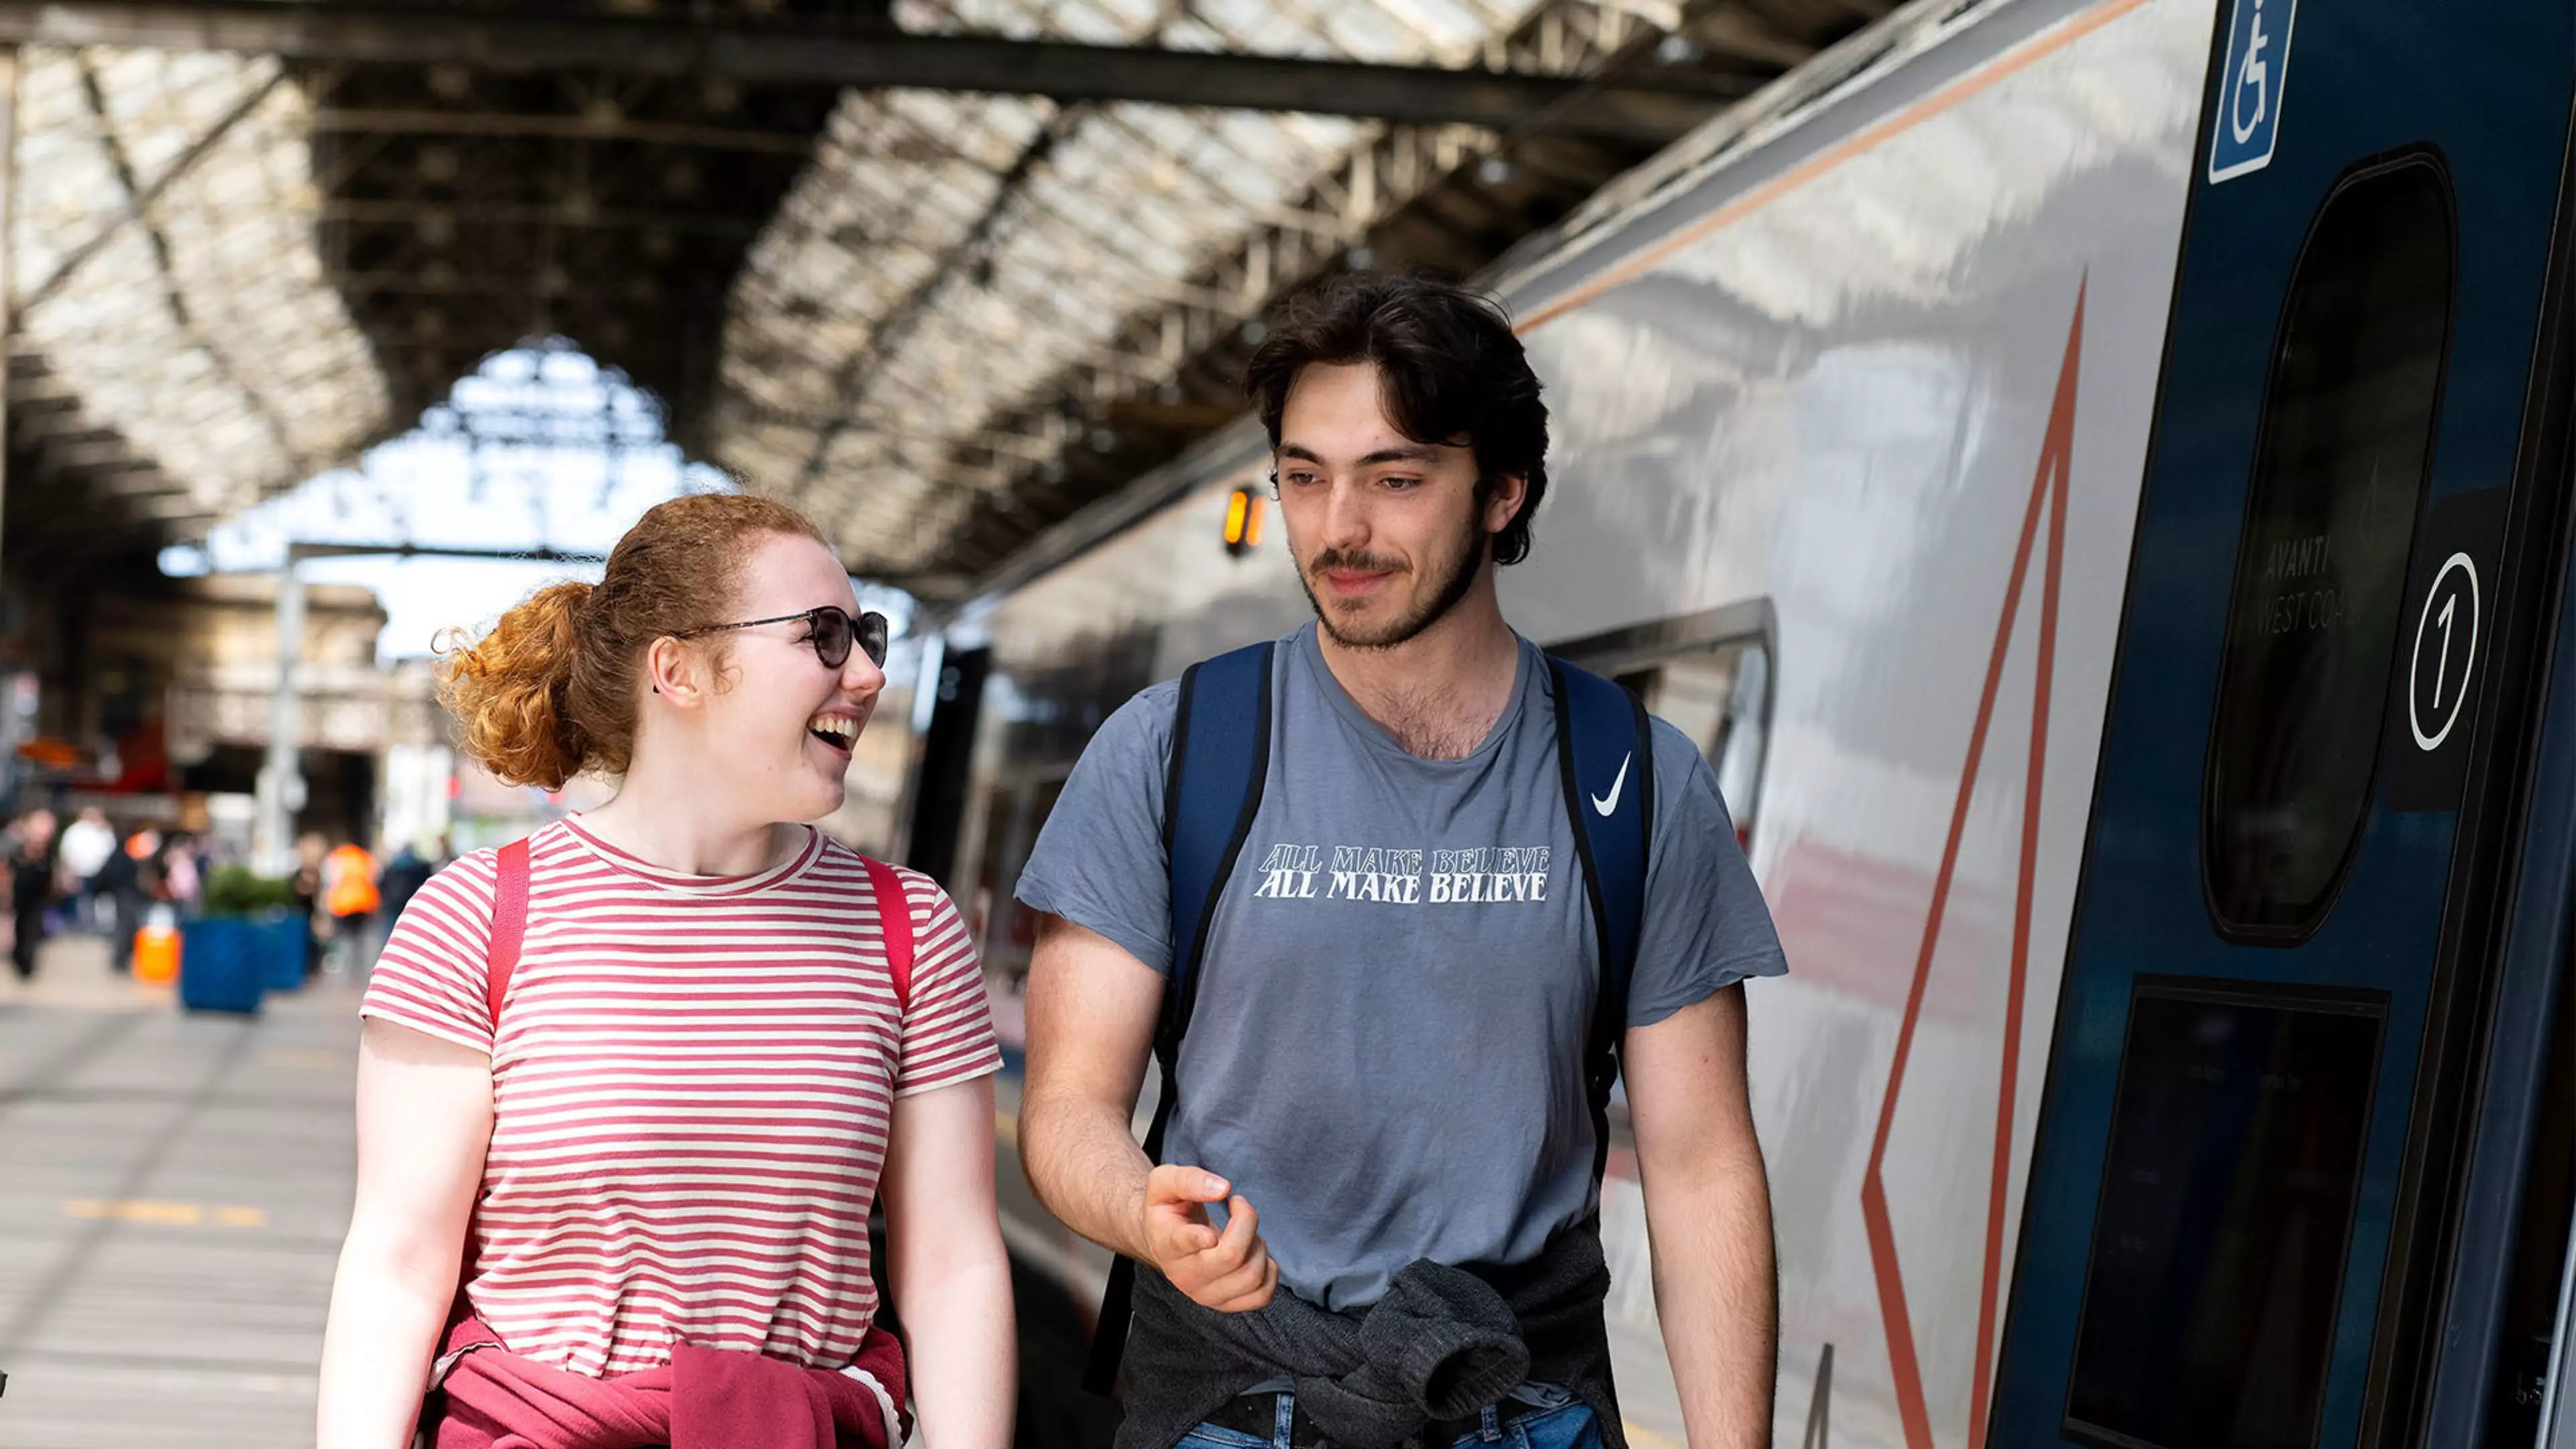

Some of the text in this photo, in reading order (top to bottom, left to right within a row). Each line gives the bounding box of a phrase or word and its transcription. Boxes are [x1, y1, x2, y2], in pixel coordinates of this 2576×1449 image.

[2265, 535, 2330, 580] AVANTI
[2257, 591, 2306, 635] WEST
[2434, 594, 2457, 709] 1
[1258, 844, 1550, 875] ALL MAKE BELIEVE
[1254, 870, 1548, 904] ALL MAKE BELIEVE
